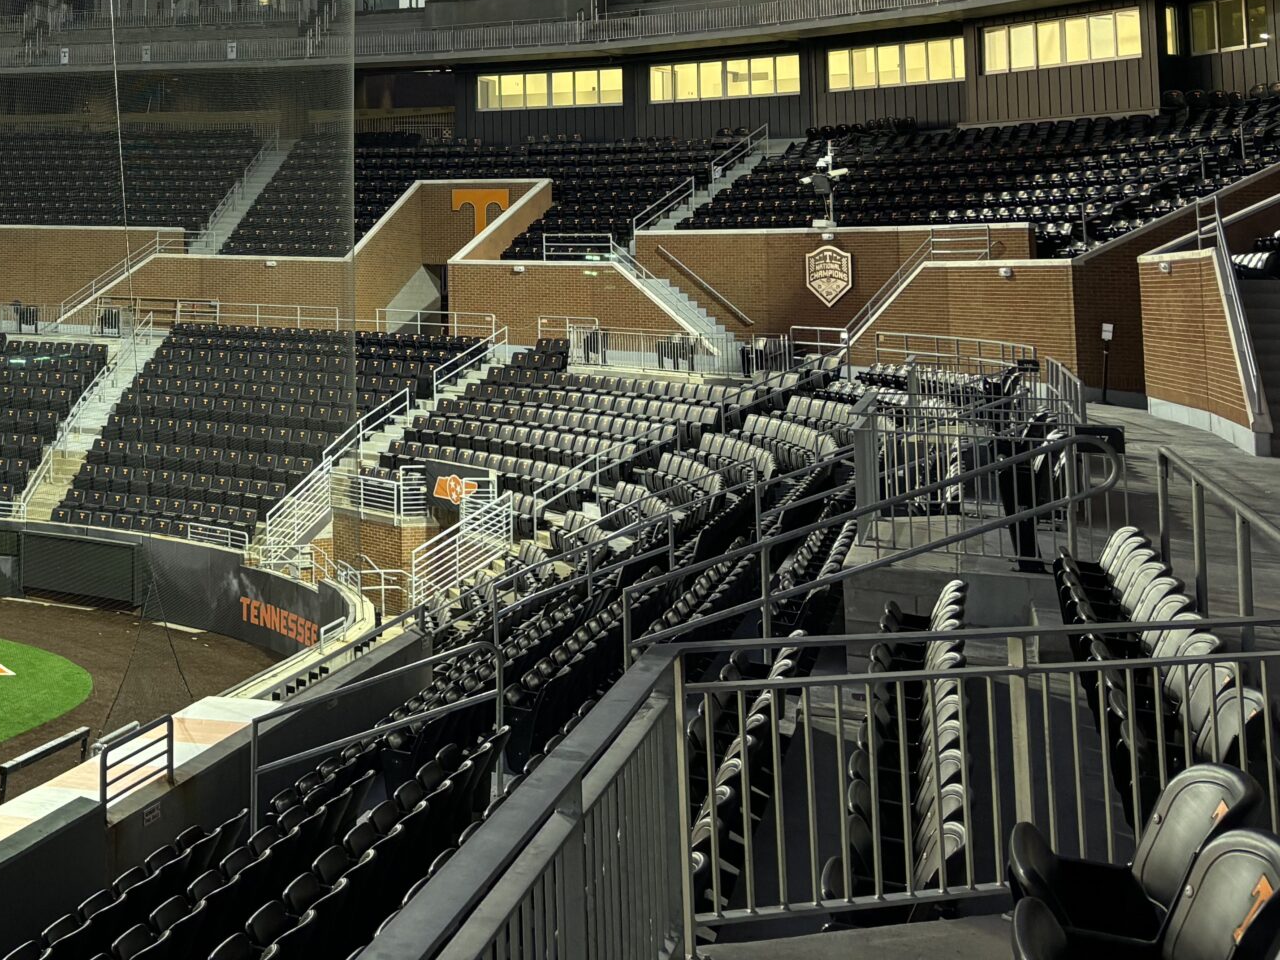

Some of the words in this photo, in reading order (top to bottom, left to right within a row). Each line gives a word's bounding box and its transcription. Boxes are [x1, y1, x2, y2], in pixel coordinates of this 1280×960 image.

[452, 189, 509, 236] T
[824, 252, 832, 263] T
[815, 262, 841, 271] NATIONAL
[810, 269, 848, 282] CHAMPIONS
[240, 596, 319, 647] TENNESSEE
